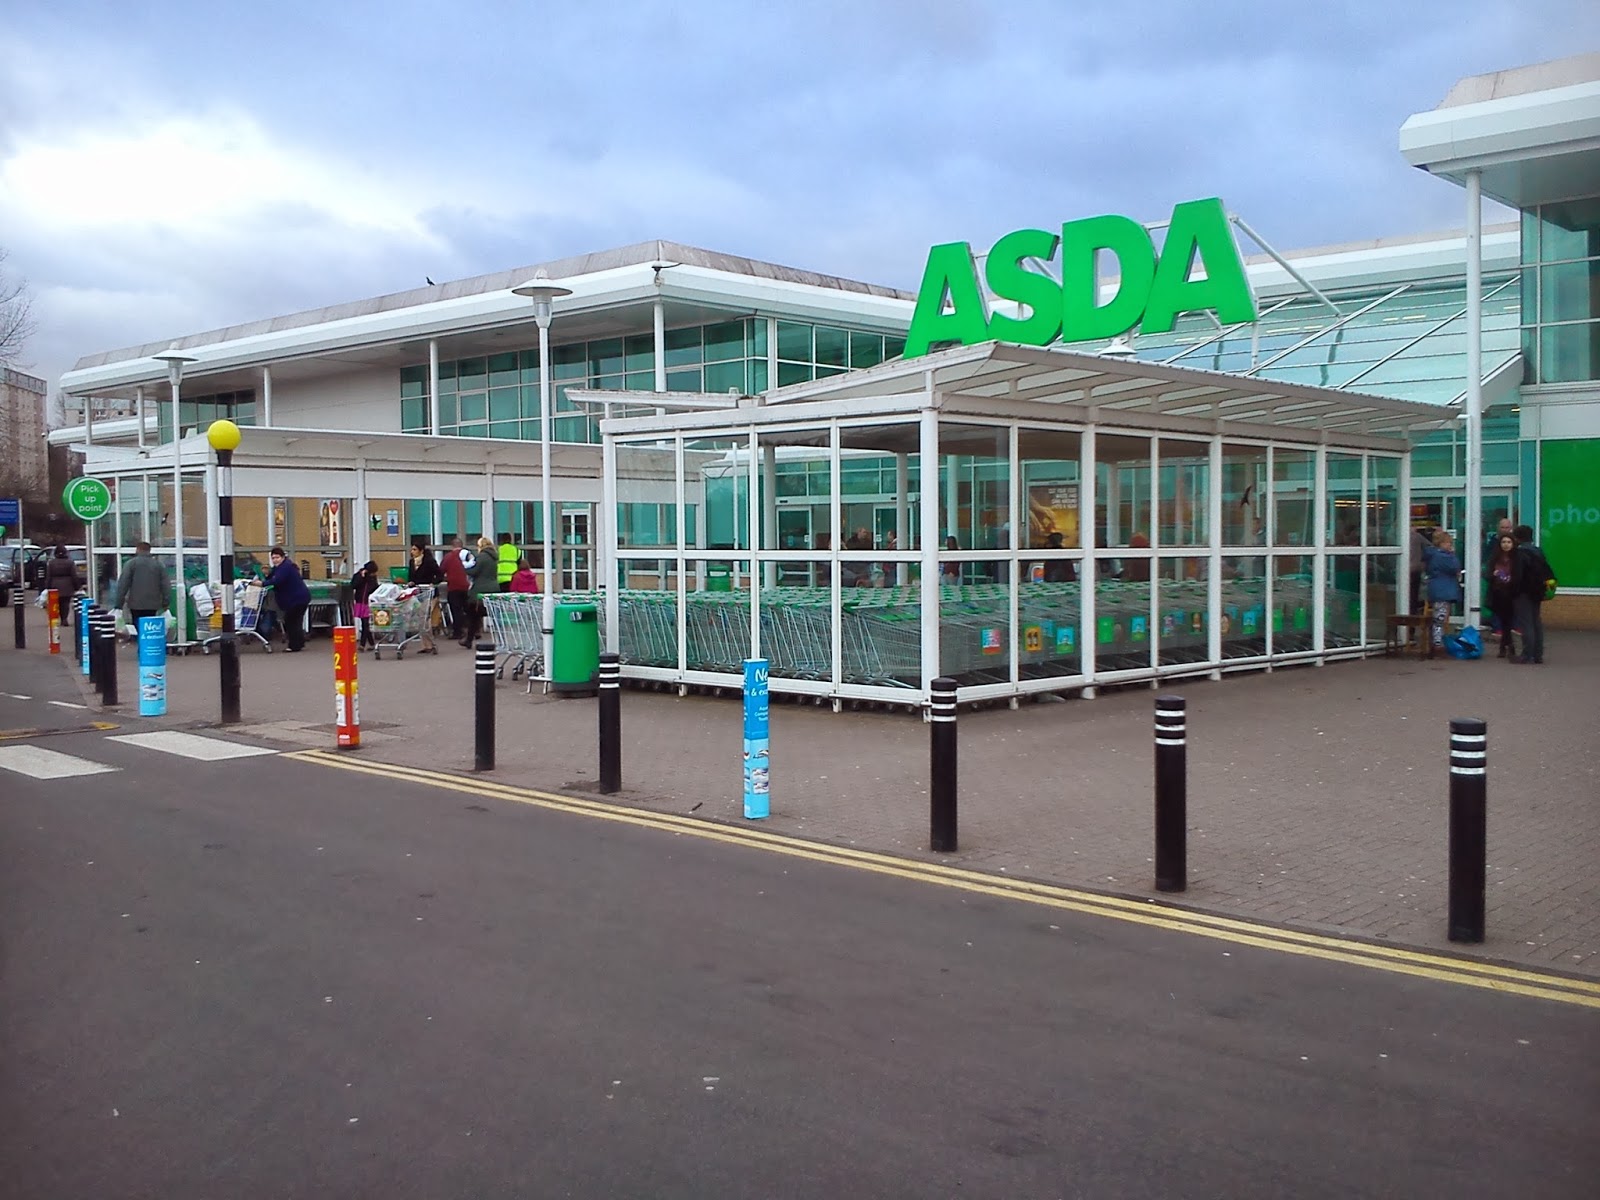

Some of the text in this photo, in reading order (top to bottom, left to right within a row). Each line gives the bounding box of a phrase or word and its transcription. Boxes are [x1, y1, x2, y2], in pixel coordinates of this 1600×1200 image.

[902, 196, 1258, 360] ASDA
[80, 485, 100, 493] Pick
[79, 504, 102, 512] point
